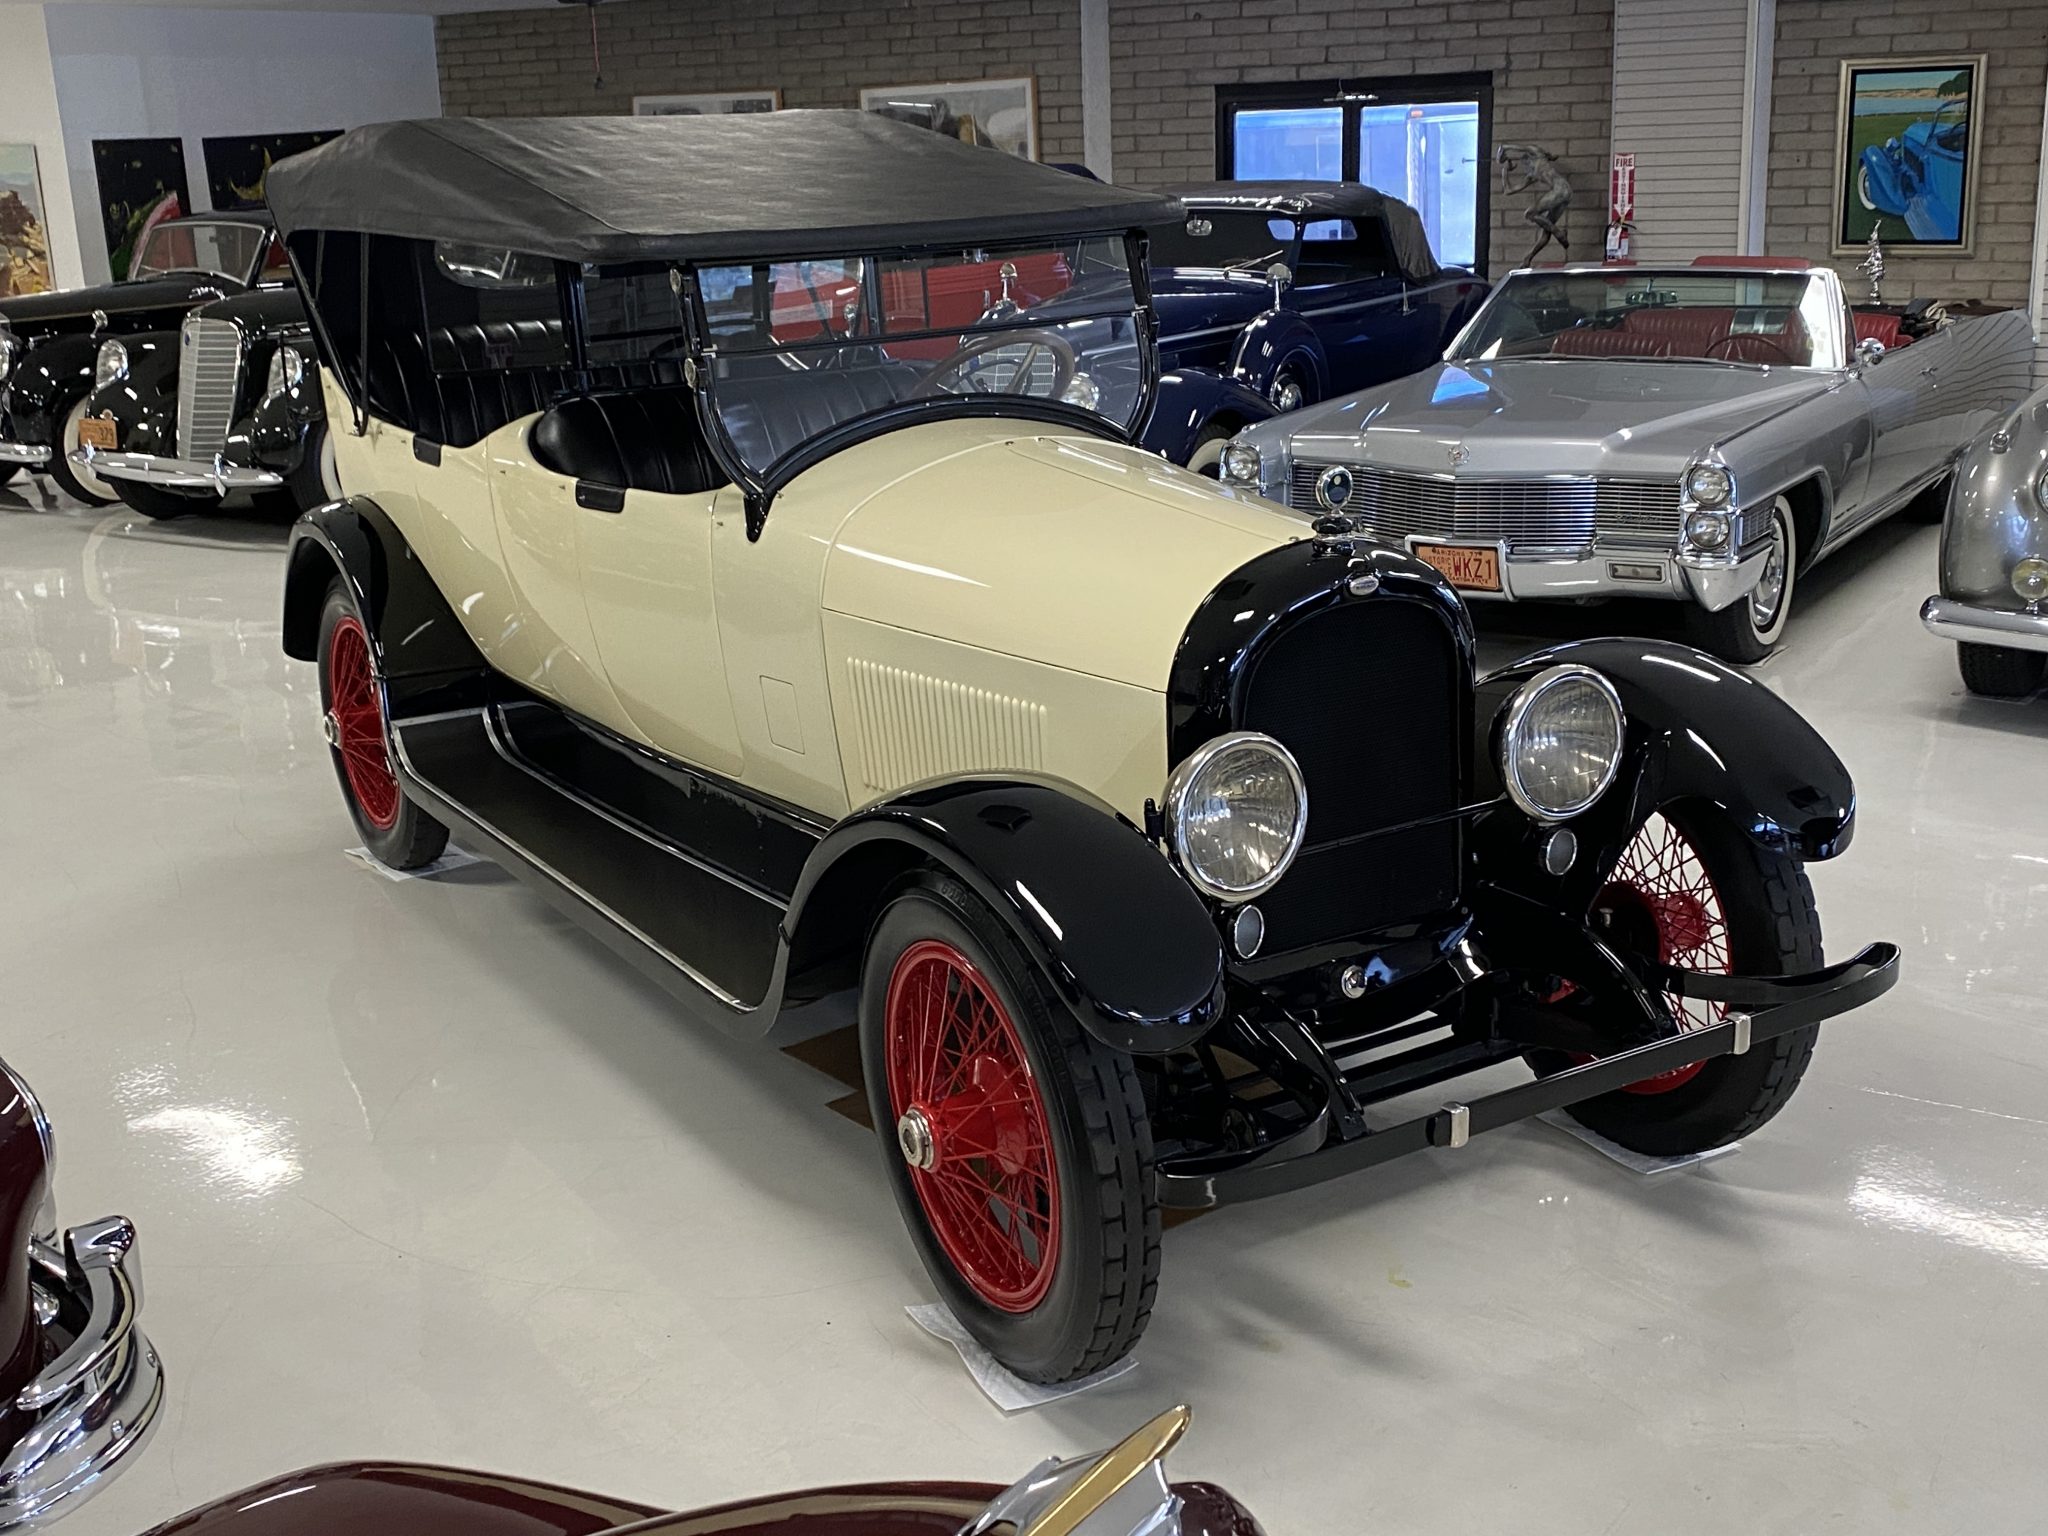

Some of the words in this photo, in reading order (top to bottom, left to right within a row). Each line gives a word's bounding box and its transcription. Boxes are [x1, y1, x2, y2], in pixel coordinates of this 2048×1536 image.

[1615, 158, 1633, 167] FIRE
[1436, 549, 1465, 557] ARIZONA
[1453, 557, 1492, 580] WKZ1
